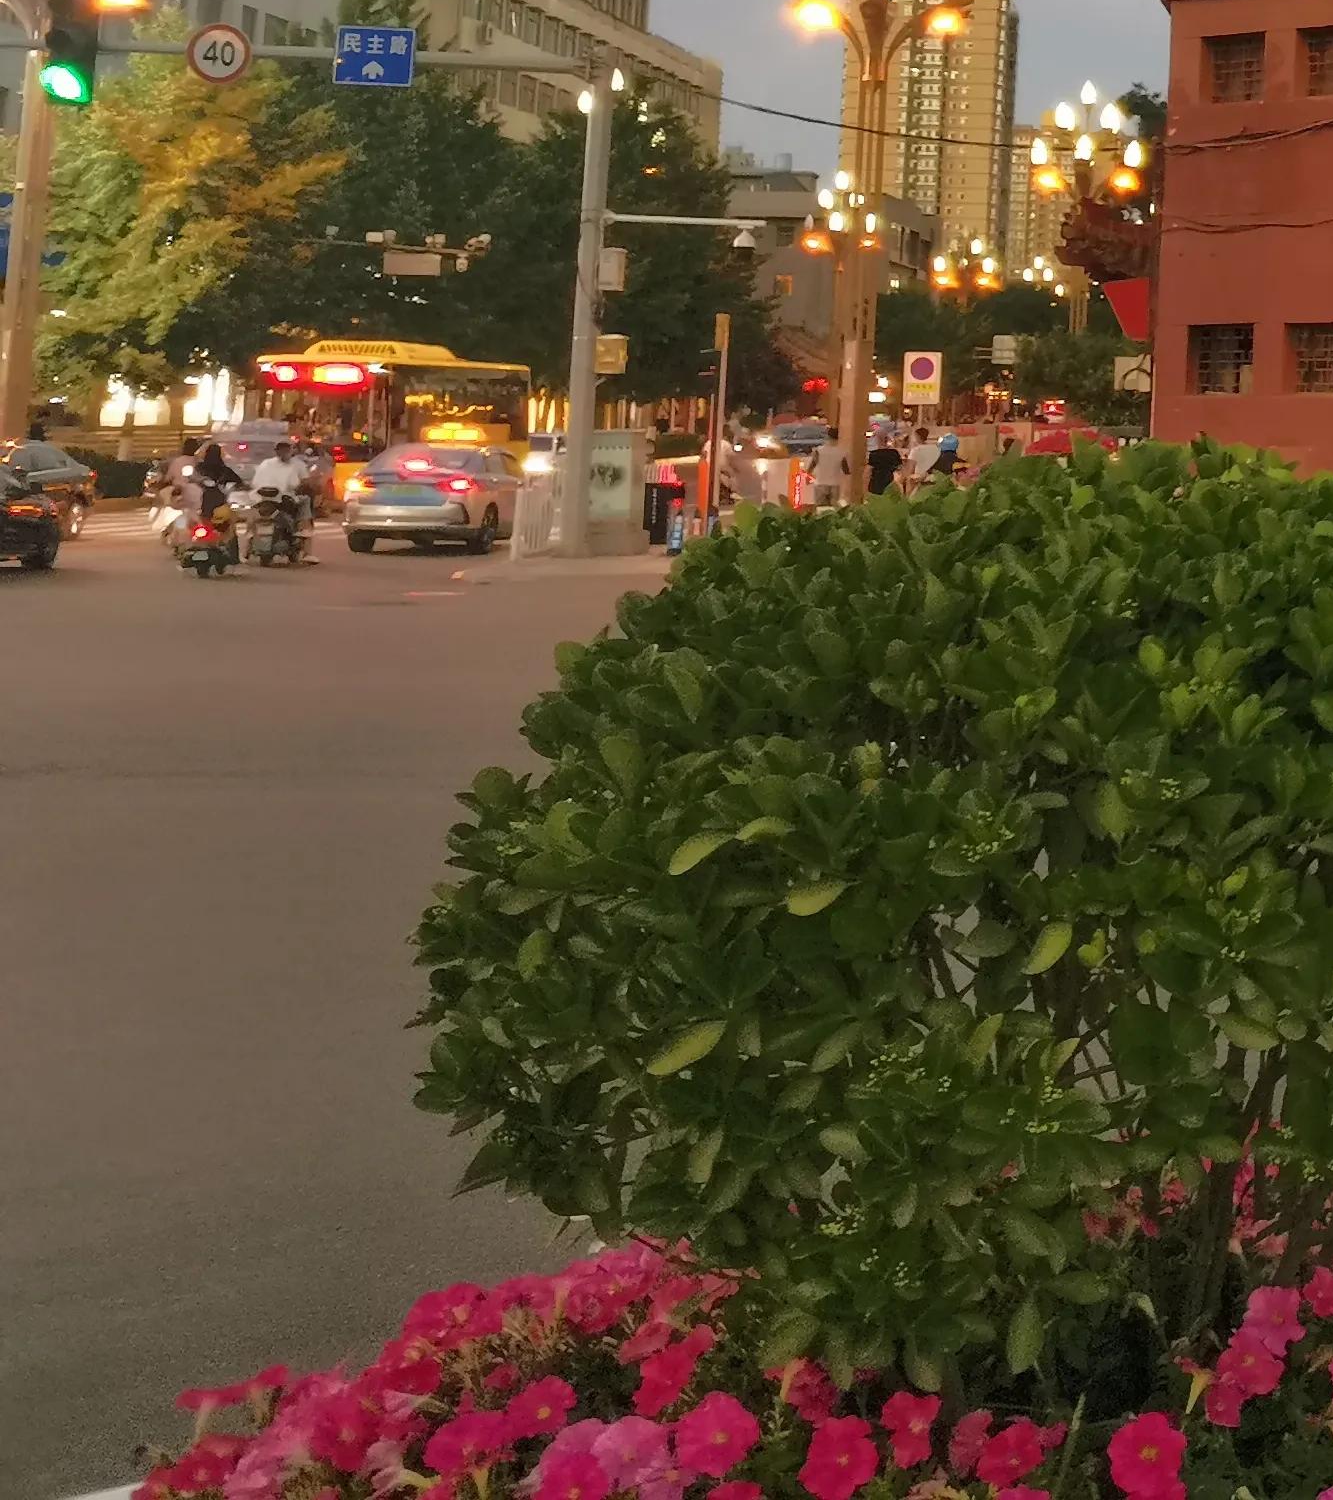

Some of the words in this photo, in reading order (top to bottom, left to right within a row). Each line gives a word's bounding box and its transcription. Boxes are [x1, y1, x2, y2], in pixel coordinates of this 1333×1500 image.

[202, 41, 236, 67] 40
[343, 32, 408, 56] 民主路
